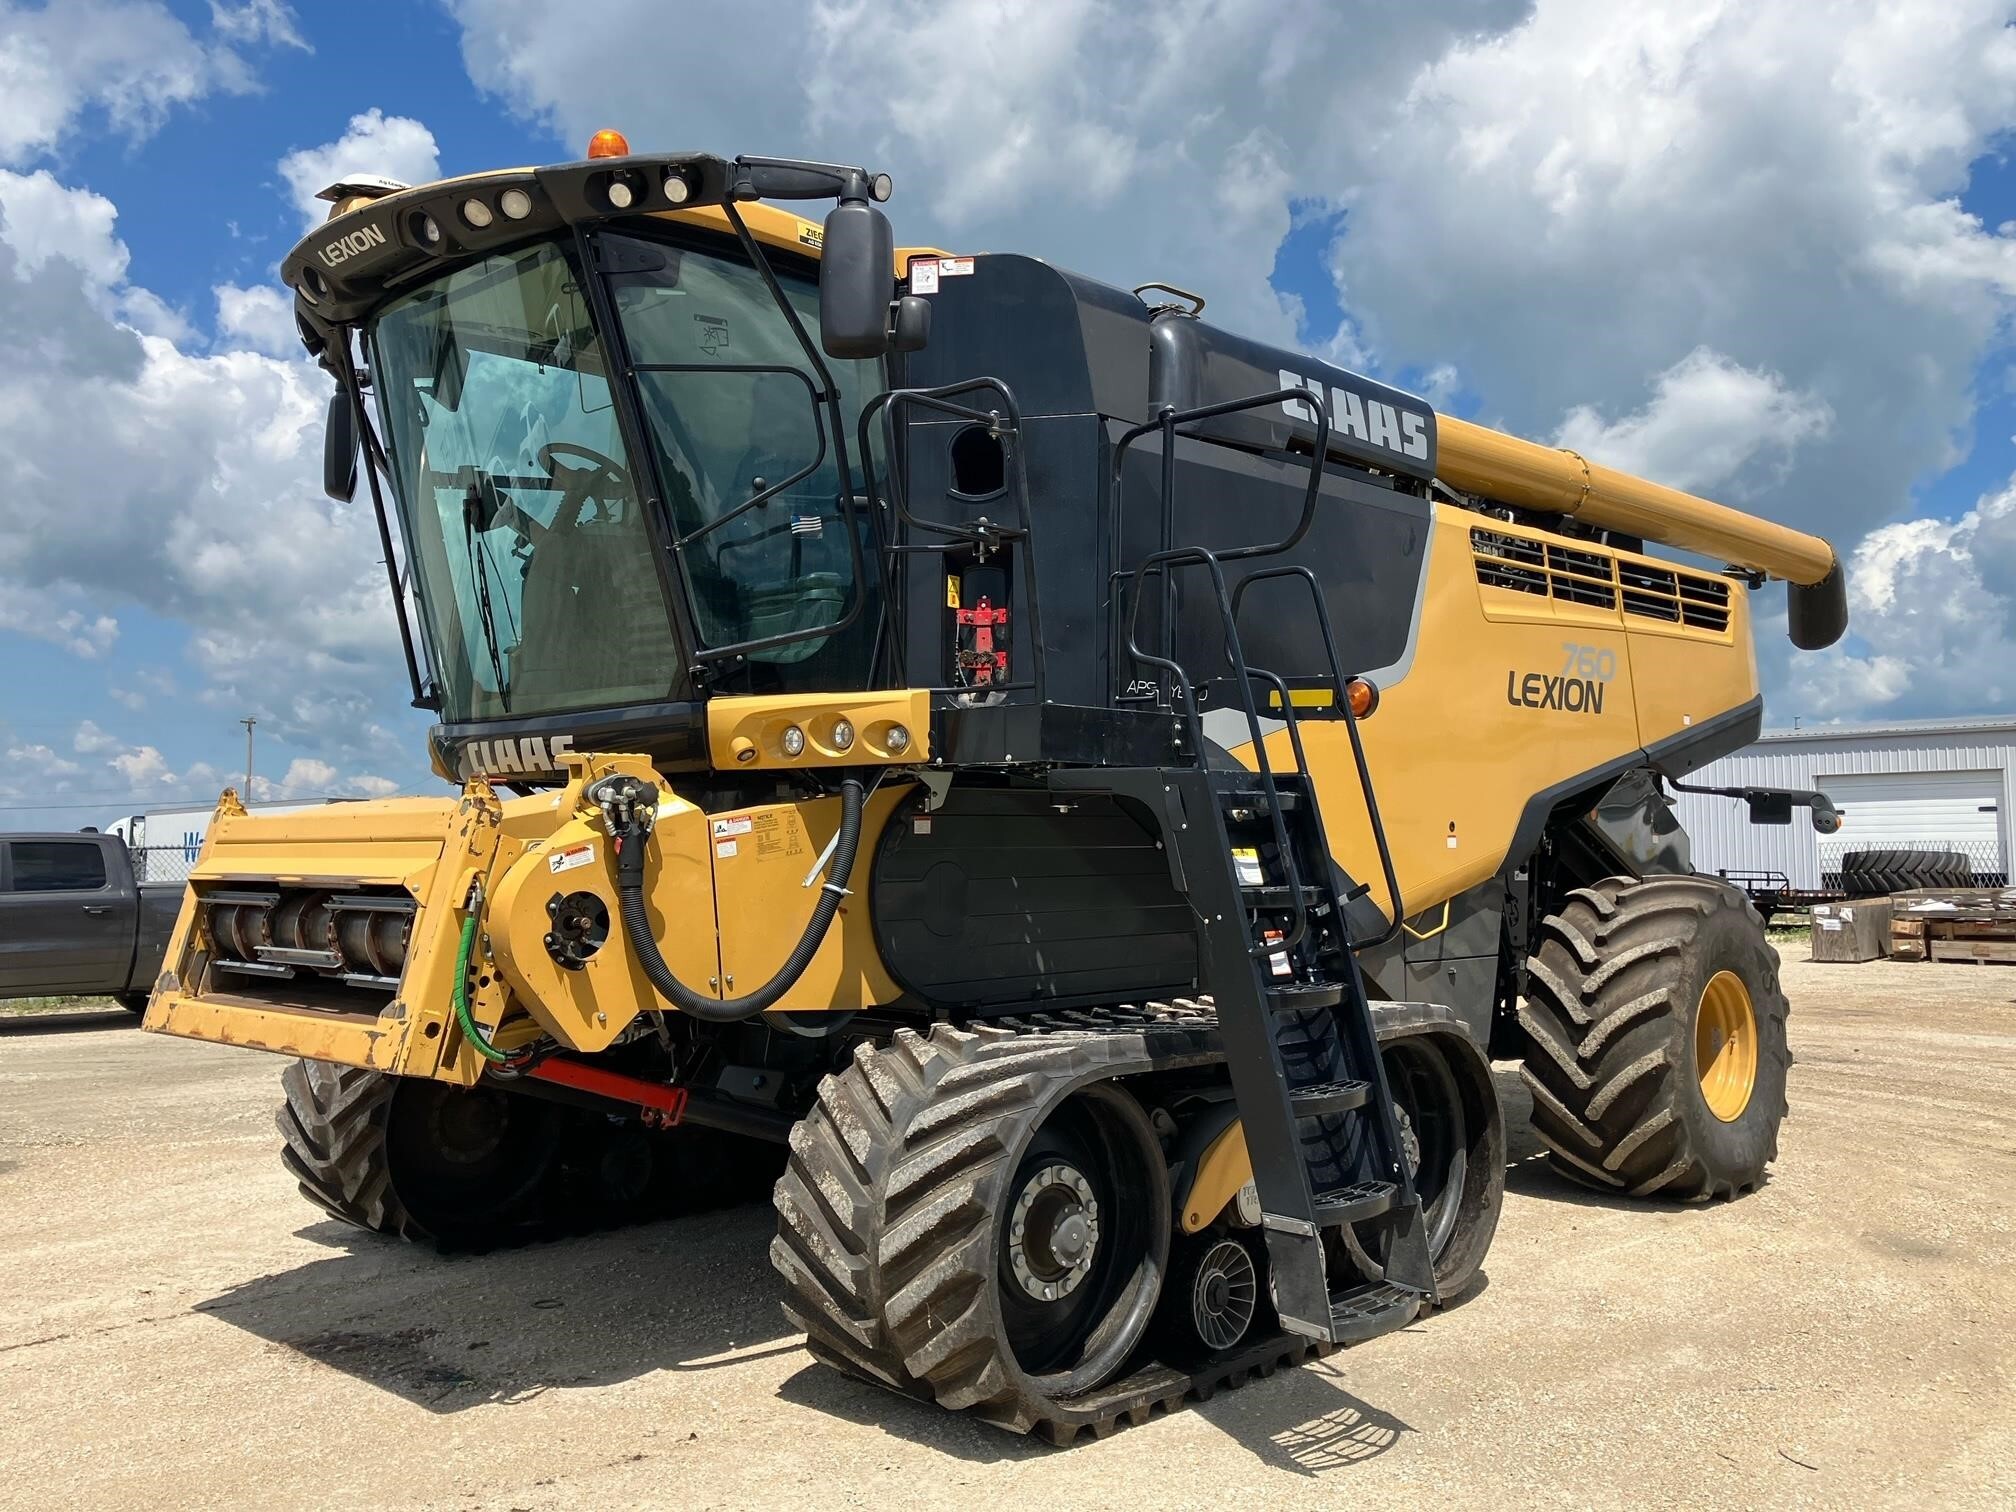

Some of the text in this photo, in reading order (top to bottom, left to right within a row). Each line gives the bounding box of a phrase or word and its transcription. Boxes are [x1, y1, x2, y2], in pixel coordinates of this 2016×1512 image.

[318, 223, 386, 267] LEXION
[1278, 369, 1428, 460] CLAAS
[1562, 643, 1617, 683] 760
[1507, 670, 1604, 714] LEXION
[466, 735, 575, 774] CLAAS
